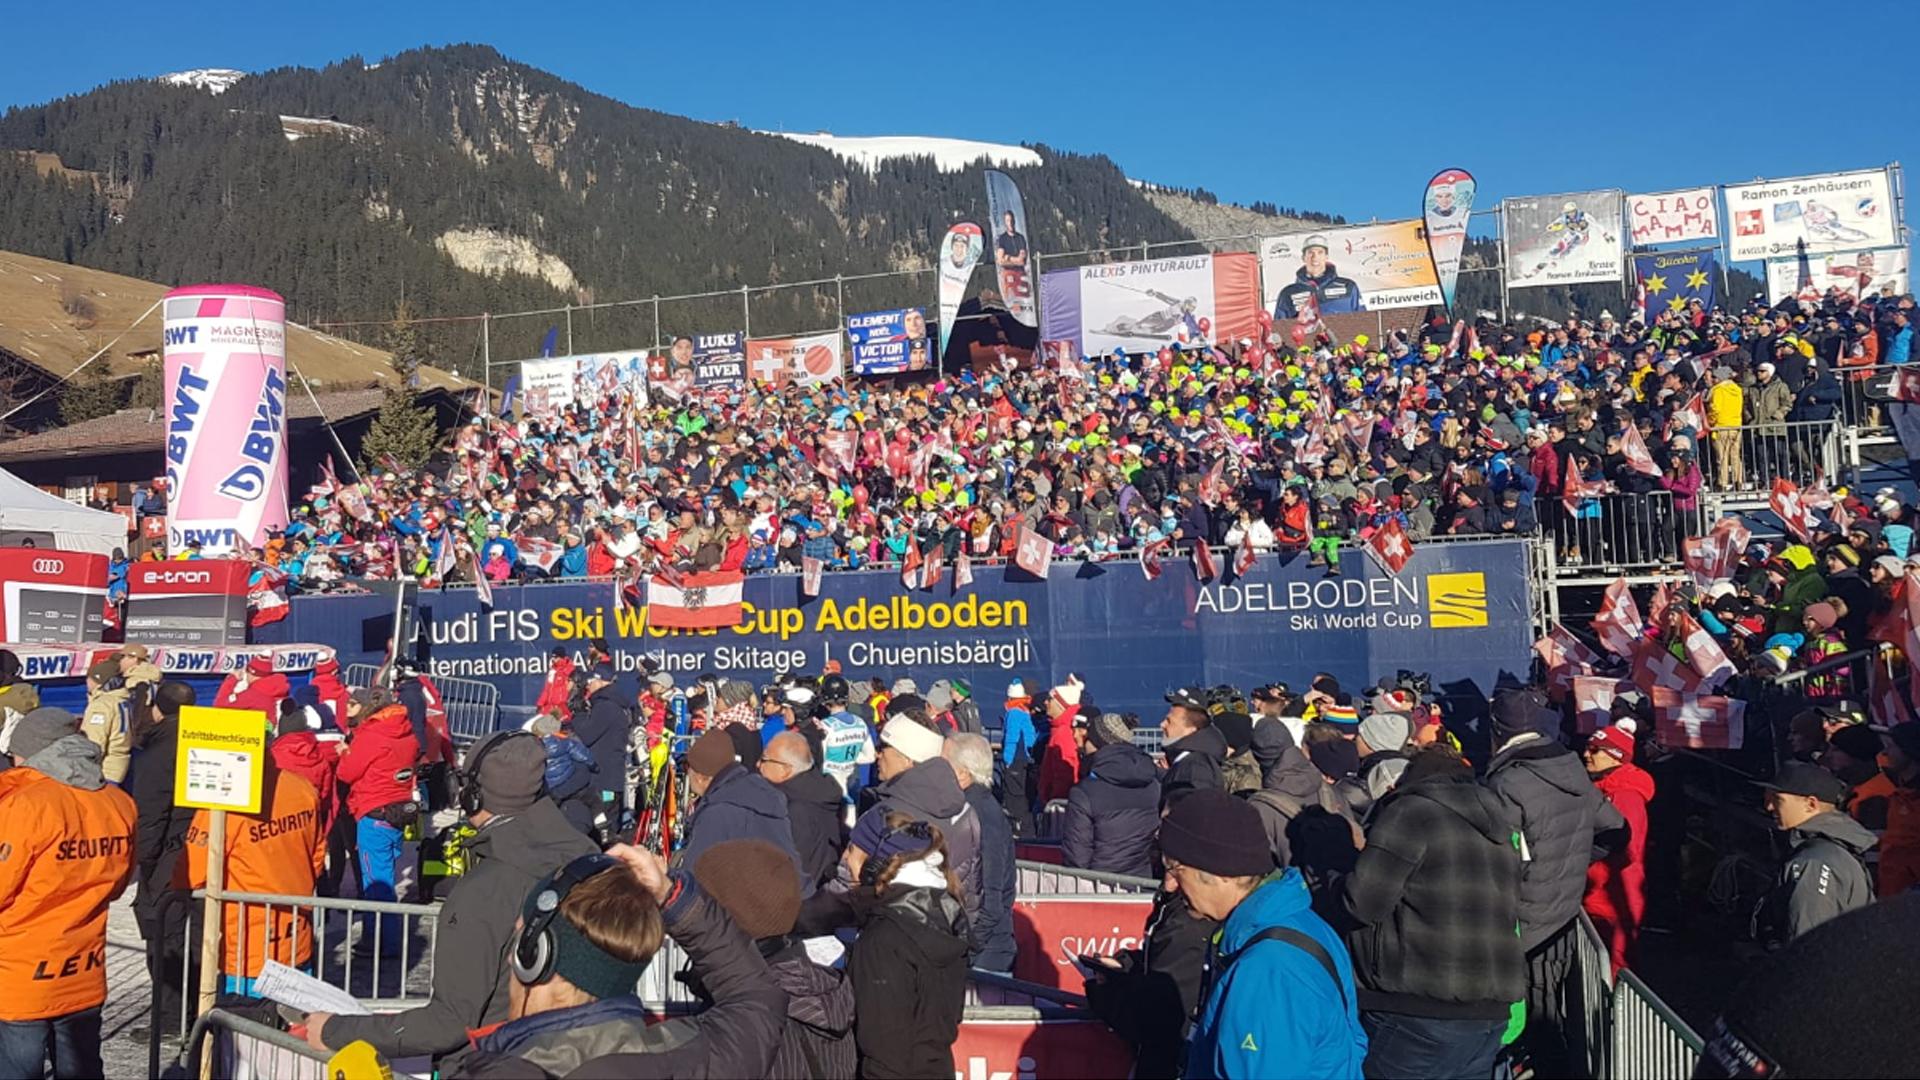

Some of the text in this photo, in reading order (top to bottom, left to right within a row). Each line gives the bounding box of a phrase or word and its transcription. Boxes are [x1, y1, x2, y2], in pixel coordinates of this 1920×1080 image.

[1742, 179, 1872, 201] Ramon Zenhäusern
[1634, 196, 1709, 216] CIAO
[1632, 212, 1713, 241] MAMMA
[1084, 258, 1208, 280] ALEXIS PINTURAULT
[1369, 289, 1439, 305] #biruweich
[850, 314, 901, 328] CLEMENT
[211, 325, 283, 341] MAGNESIUM
[699, 334, 737, 349] LUKE
[859, 342, 904, 358] VICTOR
[699, 363, 741, 378] RIVER
[168, 365, 209, 465] BWT
[242, 367, 285, 464] BWT
[184, 528, 236, 547] BWT
[143, 571, 210, 584] e-tron
[1194, 577, 1419, 614] ADELBODEN
[409, 611, 478, 644] Audi
[490, 609, 536, 642] FIS
[551, 607, 603, 640] Ski
[732, 601, 804, 640] Cup
[815, 594, 1028, 632] Adelboden
[1290, 611, 1422, 631] Ski World Cup
[25, 655, 69, 676] BWT
[176, 652, 214, 671] BWT
[287, 651, 318, 668] BWT
[428, 651, 554, 677] ternational
[714, 643, 807, 674] Skitage
[849, 638, 1030, 669] Chuenisbärgli
[249, 808, 316, 843] SECURITY
[55, 835, 134, 861] SECURITY
[1818, 863, 1832, 895] LEKI
